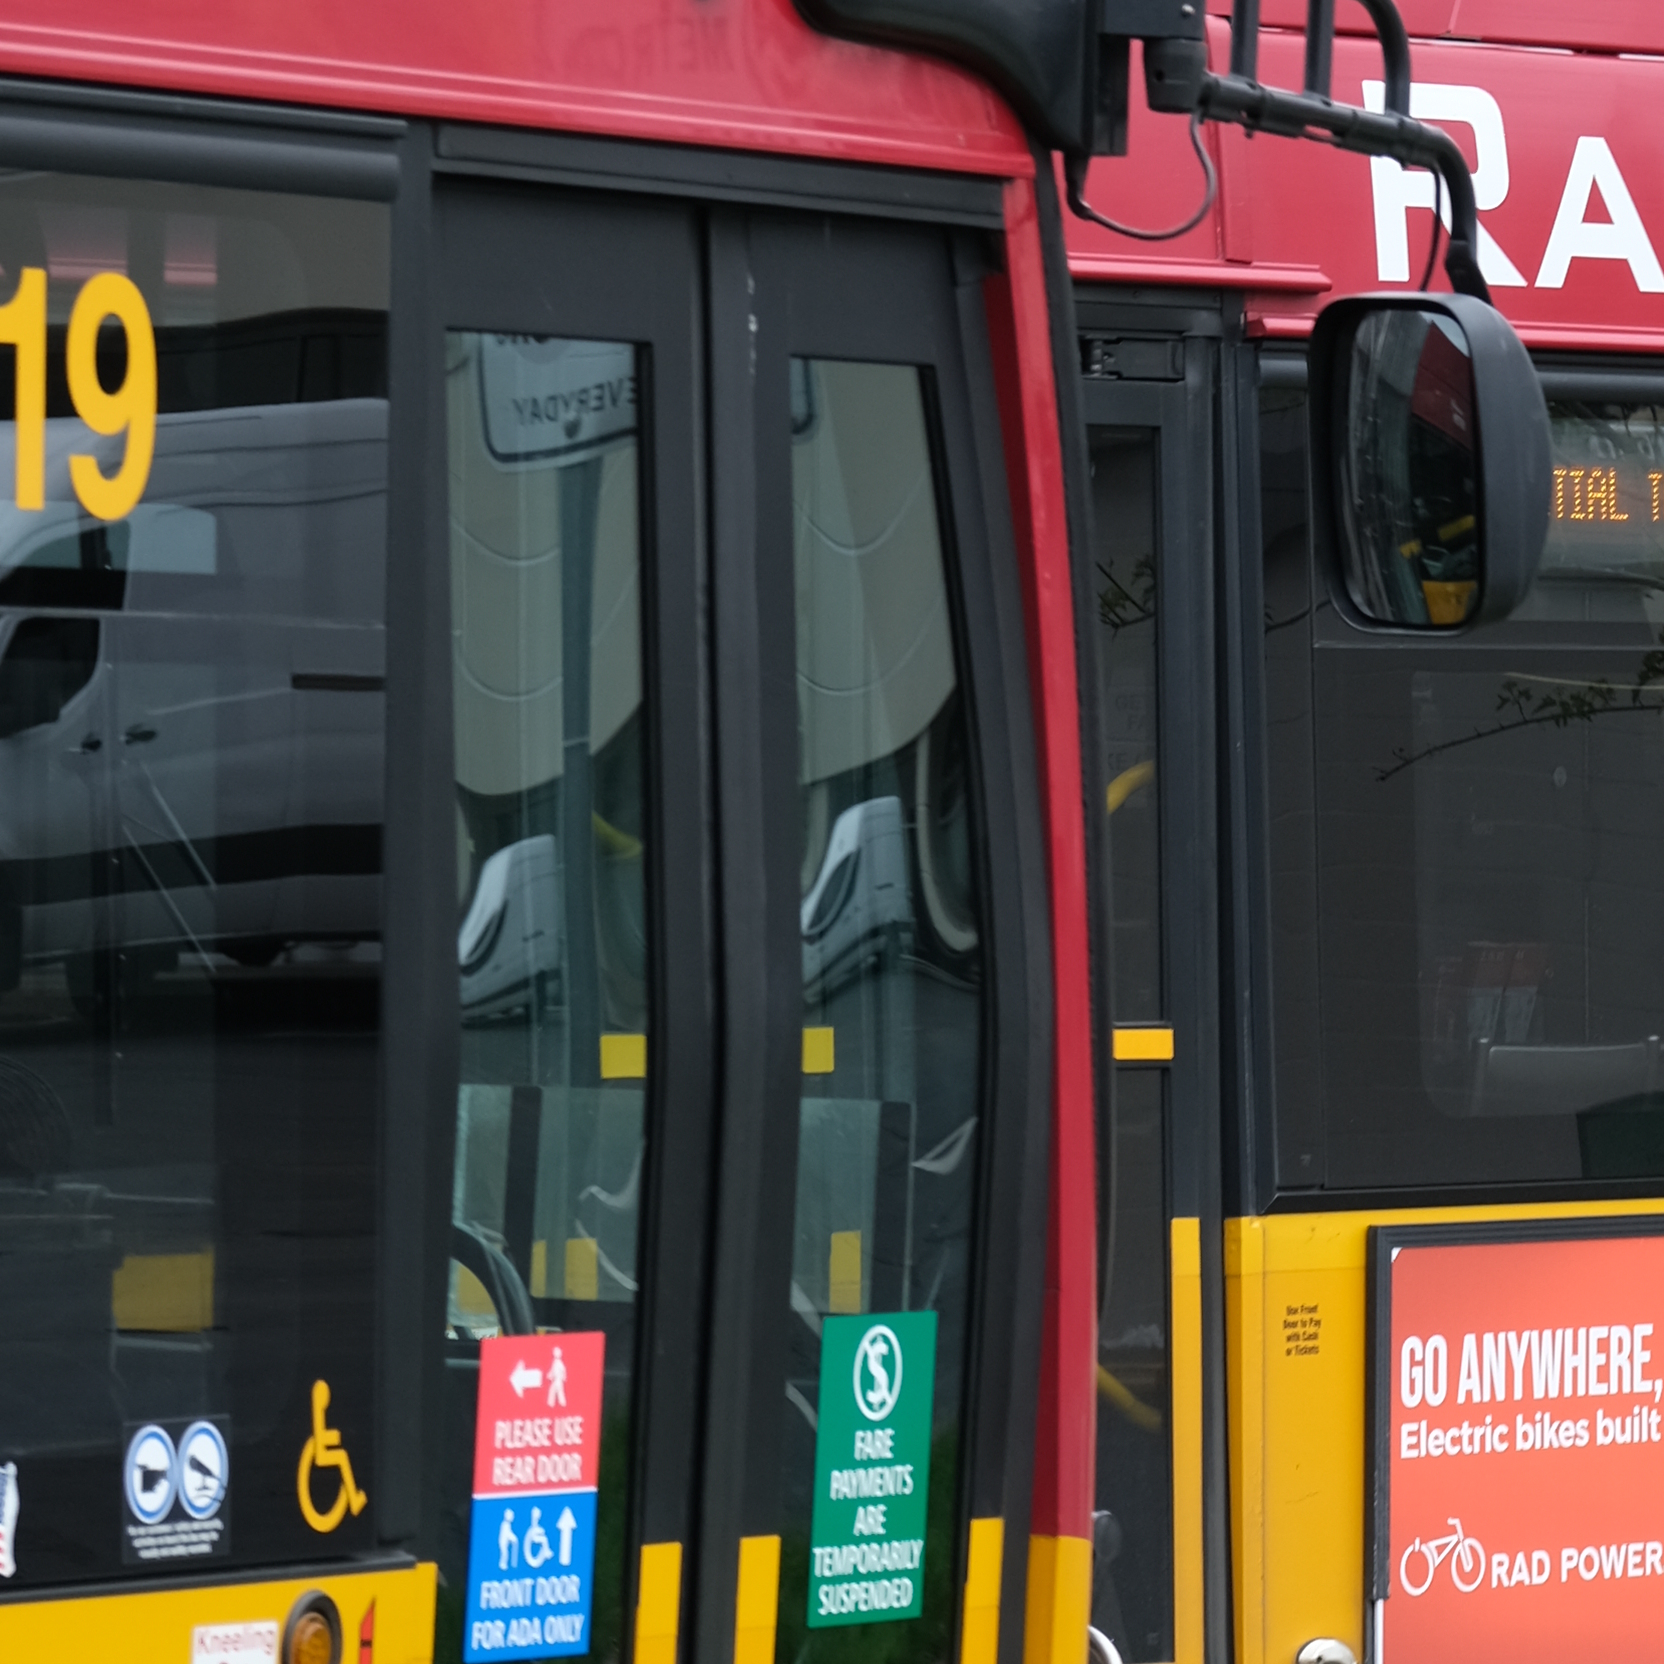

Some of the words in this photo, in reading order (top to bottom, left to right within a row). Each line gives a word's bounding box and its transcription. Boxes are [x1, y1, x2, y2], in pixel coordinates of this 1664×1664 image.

[0, 266, 157, 521] 19
[1399, 1333, 1447, 1409] GO
[1456, 1322, 1664, 1406] ANYWHERE,
[494, 1417, 552, 1450] PLEASE
[553, 1415, 584, 1446] USE
[853, 1428, 895, 1461] FARE
[1399, 1414, 1509, 1460] Electric
[1515, 1411, 1590, 1453] bikes
[1596, 1404, 1662, 1447] built
[492, 1455, 535, 1486] REAR
[537, 1452, 582, 1484] DOOR
[829, 1463, 914, 1501] PAYMENTS
[852, 1503, 887, 1537] ARE
[811, 1539, 924, 1578] TEMPORARILY
[1491, 1549, 1551, 1589] RAD
[1560, 1540, 1664, 1584] POWER
[479, 1577, 535, 1610] FRONT
[535, 1574, 581, 1607] DOOR
[817, 1577, 914, 1616] SUSPENDED
[471, 1619, 506, 1652] FOR
[506, 1616, 543, 1648] ADA
[543, 1612, 585, 1645] ONLY
